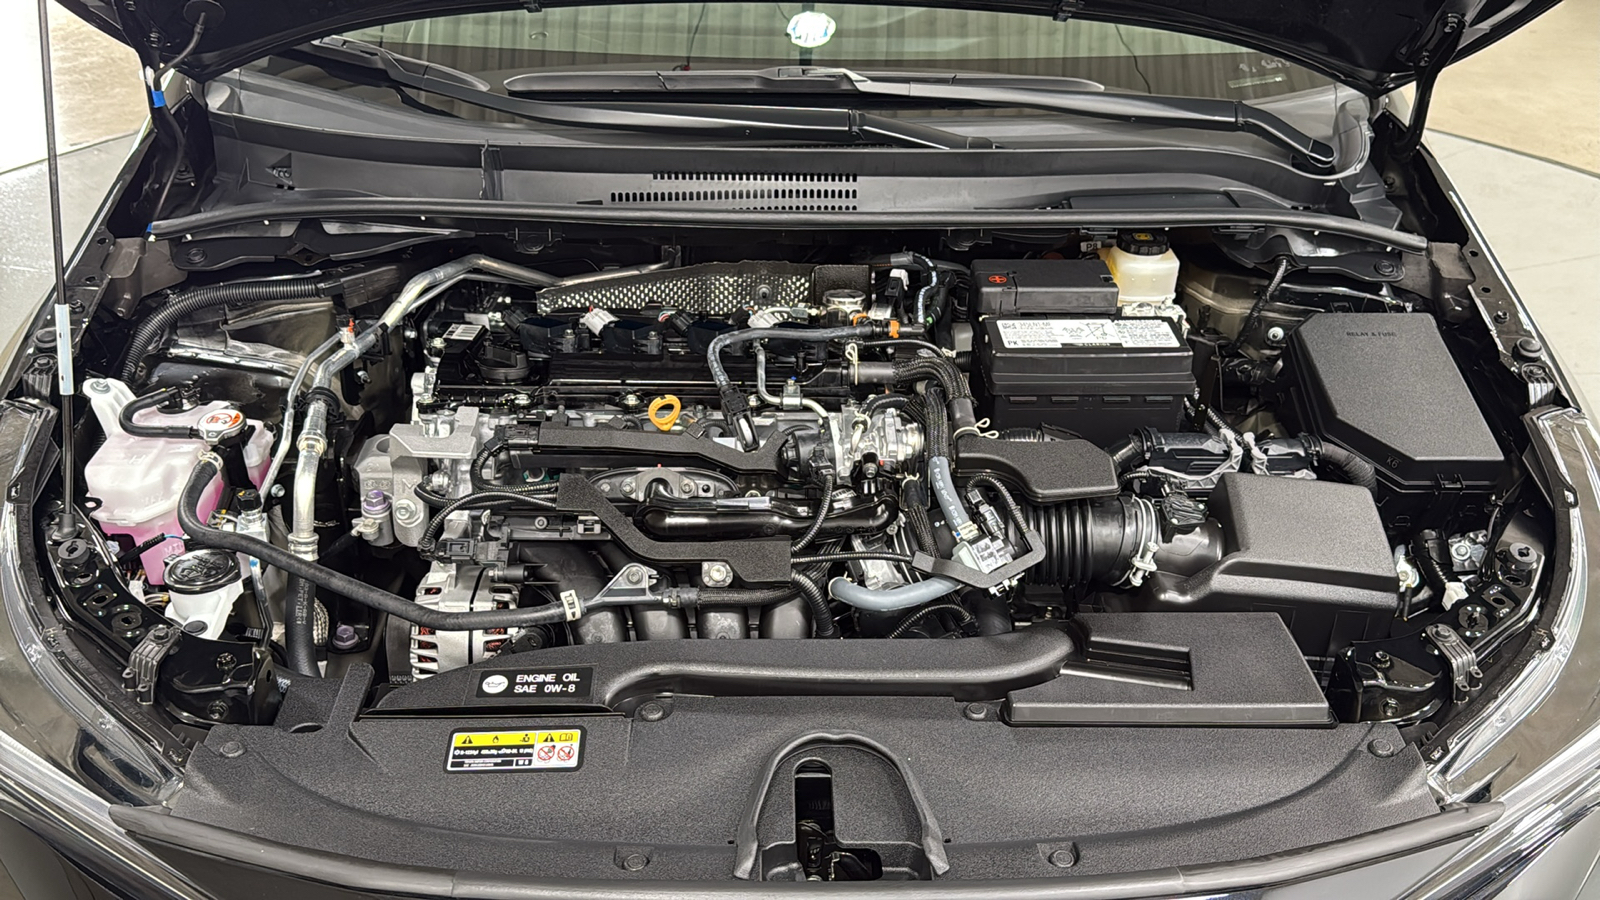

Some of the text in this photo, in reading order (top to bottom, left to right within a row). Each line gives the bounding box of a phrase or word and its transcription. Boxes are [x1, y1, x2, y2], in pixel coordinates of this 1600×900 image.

[1386, 455, 1400, 469] K6
[516, 673, 580, 683] ENGINE OIL
[513, 684, 576, 693] SAE 0W-8
